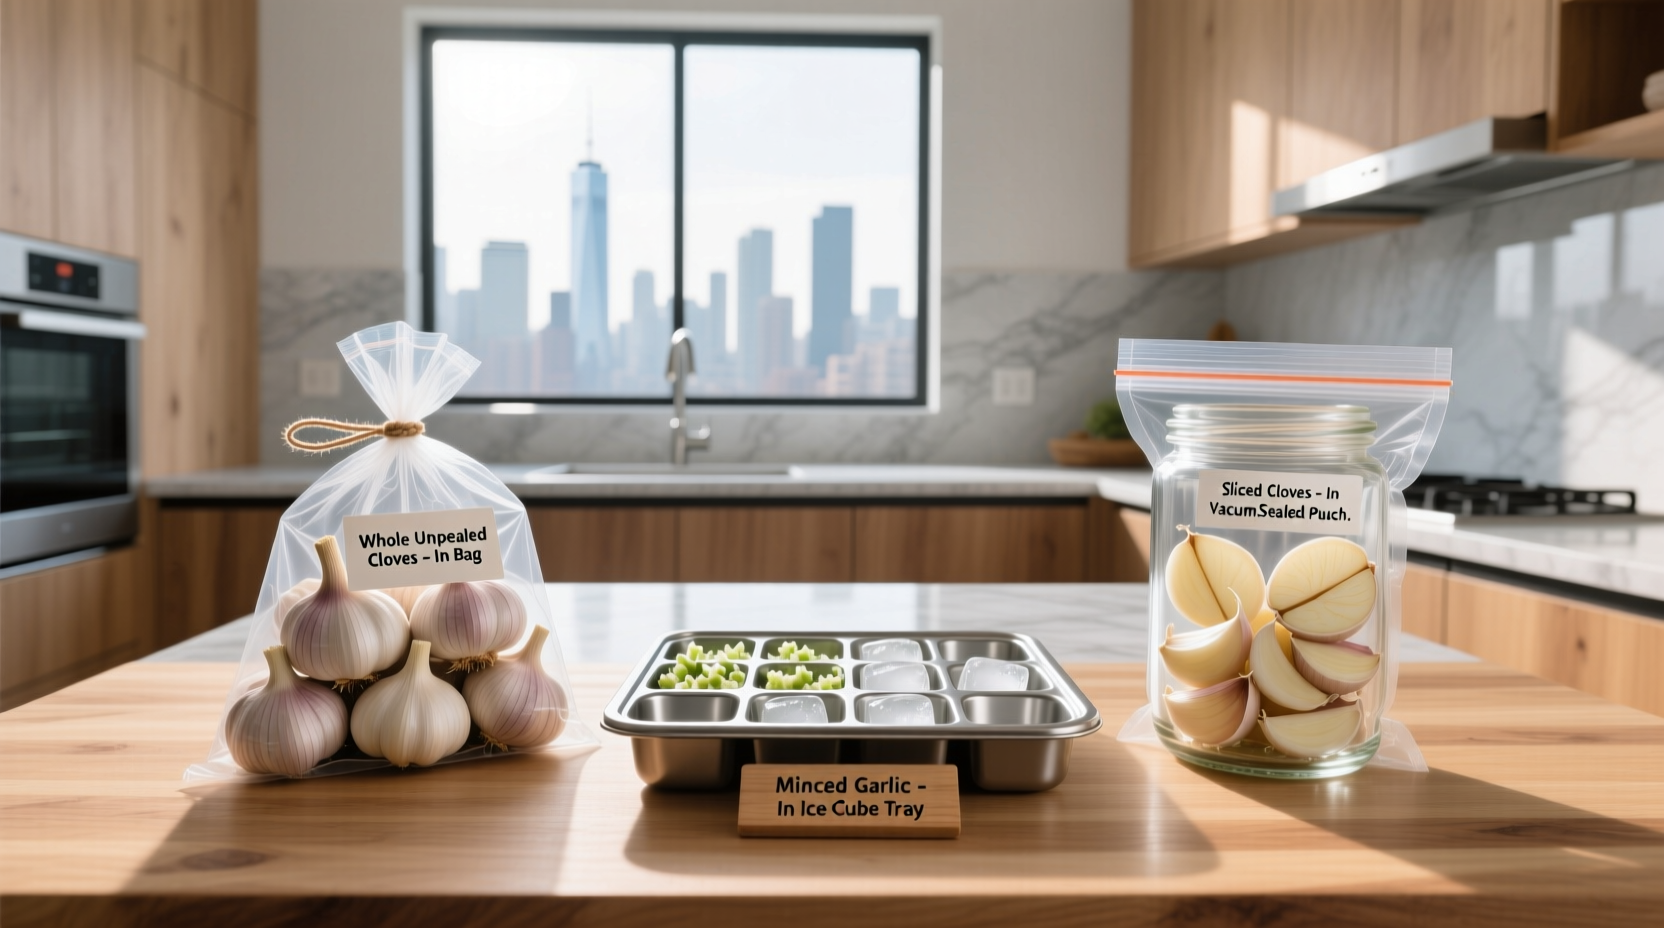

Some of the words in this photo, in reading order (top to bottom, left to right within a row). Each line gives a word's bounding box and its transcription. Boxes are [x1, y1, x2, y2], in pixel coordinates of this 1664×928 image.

[1222, 481, 1262, 497] Sliced
[1267, 483, 1312, 499] Cloves
[1326, 486, 1340, 500] In
[358, 531, 410, 549] Whole
[414, 526, 487, 547] Unpealed
[367, 551, 418, 568] Cloves
[434, 549, 450, 563] In
[453, 547, 483, 565] Bag
[775, 776, 847, 794] Minced
[854, 776, 911, 794] Garlic
[777, 800, 795, 817] In
[800, 800, 827, 817] Ice
[831, 799, 879, 817] Cube
[884, 800, 925, 821] Tray
